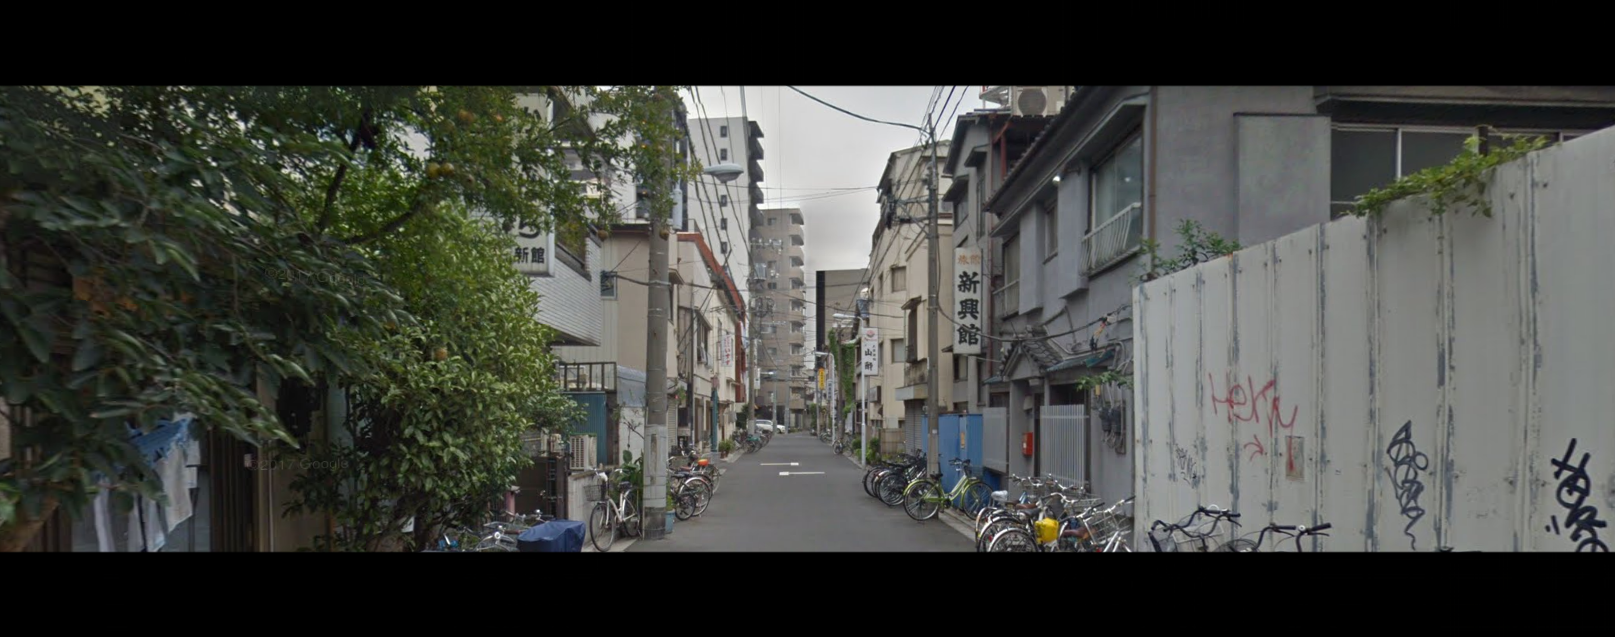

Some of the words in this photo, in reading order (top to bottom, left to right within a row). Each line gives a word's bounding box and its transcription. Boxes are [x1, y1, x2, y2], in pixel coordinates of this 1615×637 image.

[515, 247, 545, 264] 新館
[956, 270, 982, 346] 新興館
